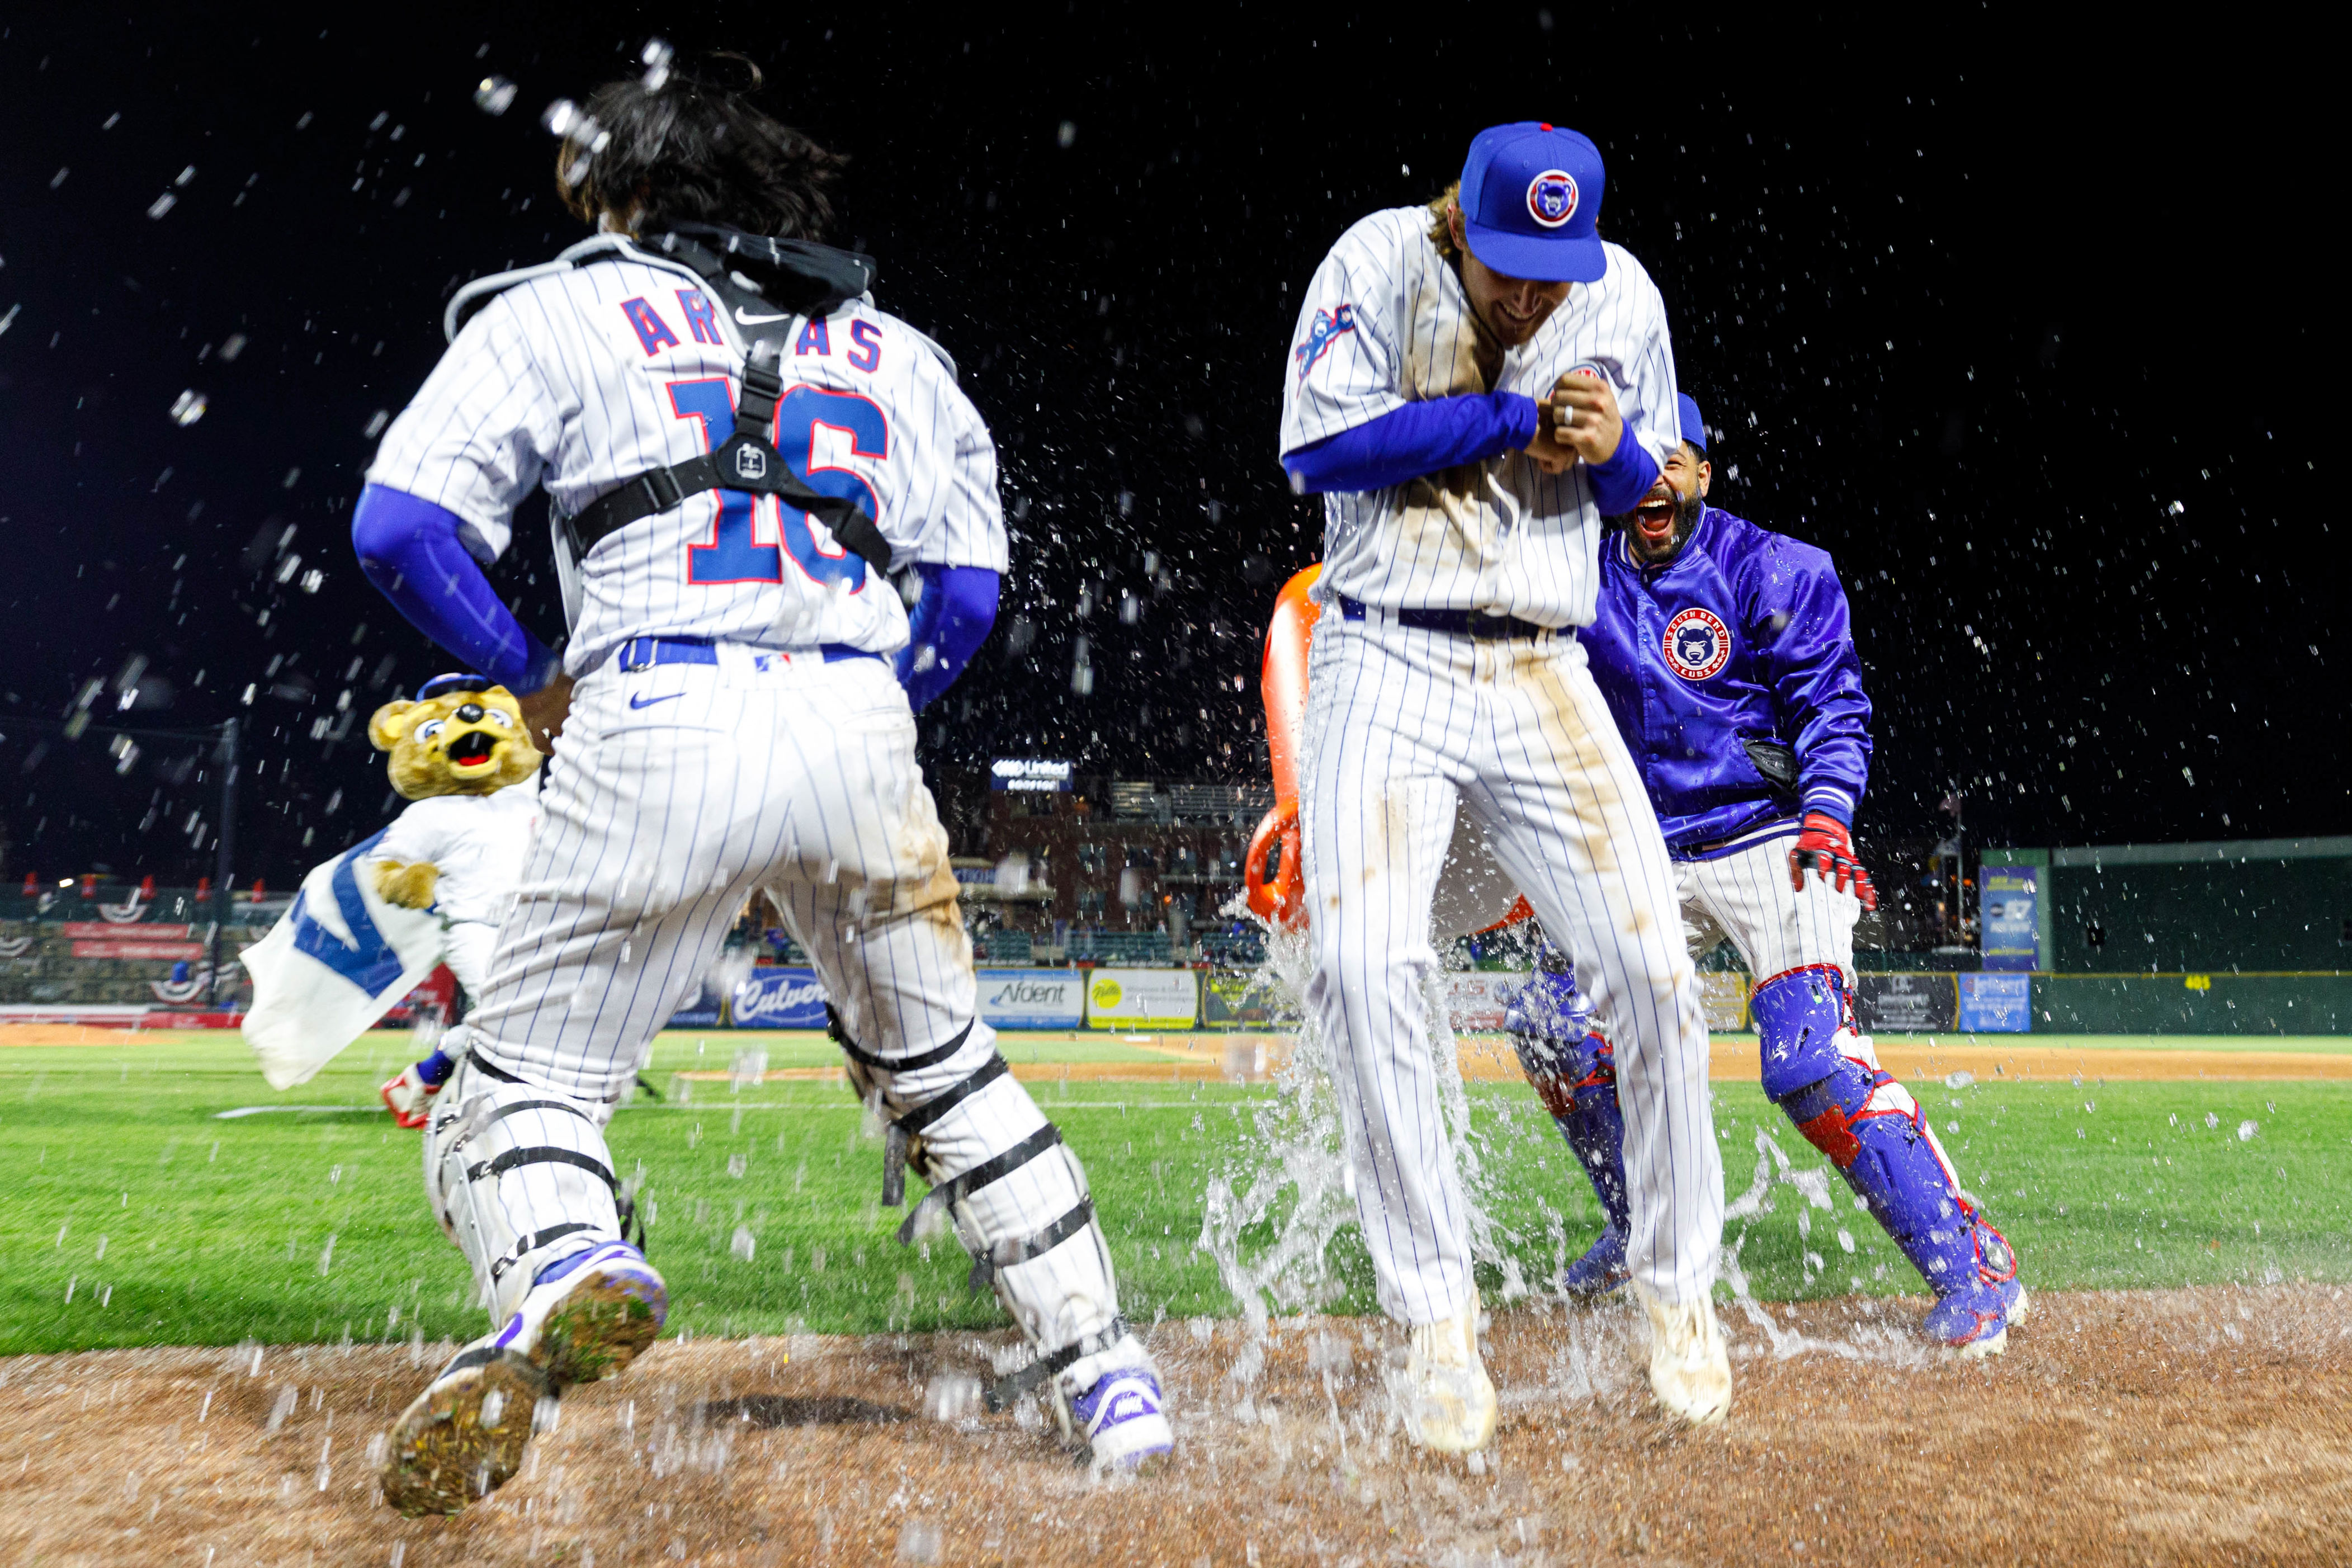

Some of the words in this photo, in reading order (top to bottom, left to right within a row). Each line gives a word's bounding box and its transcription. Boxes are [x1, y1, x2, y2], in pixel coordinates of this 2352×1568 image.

[620, 289, 882, 374] ARAS
[665, 377, 888, 595] 16
[1667, 611, 1695, 637] SOUTH
[1700, 612, 1726, 637] BEND
[1680, 668, 1711, 678] CUBS
[1024, 759, 1070, 776] United
[998, 981, 1065, 1003] Afdent
